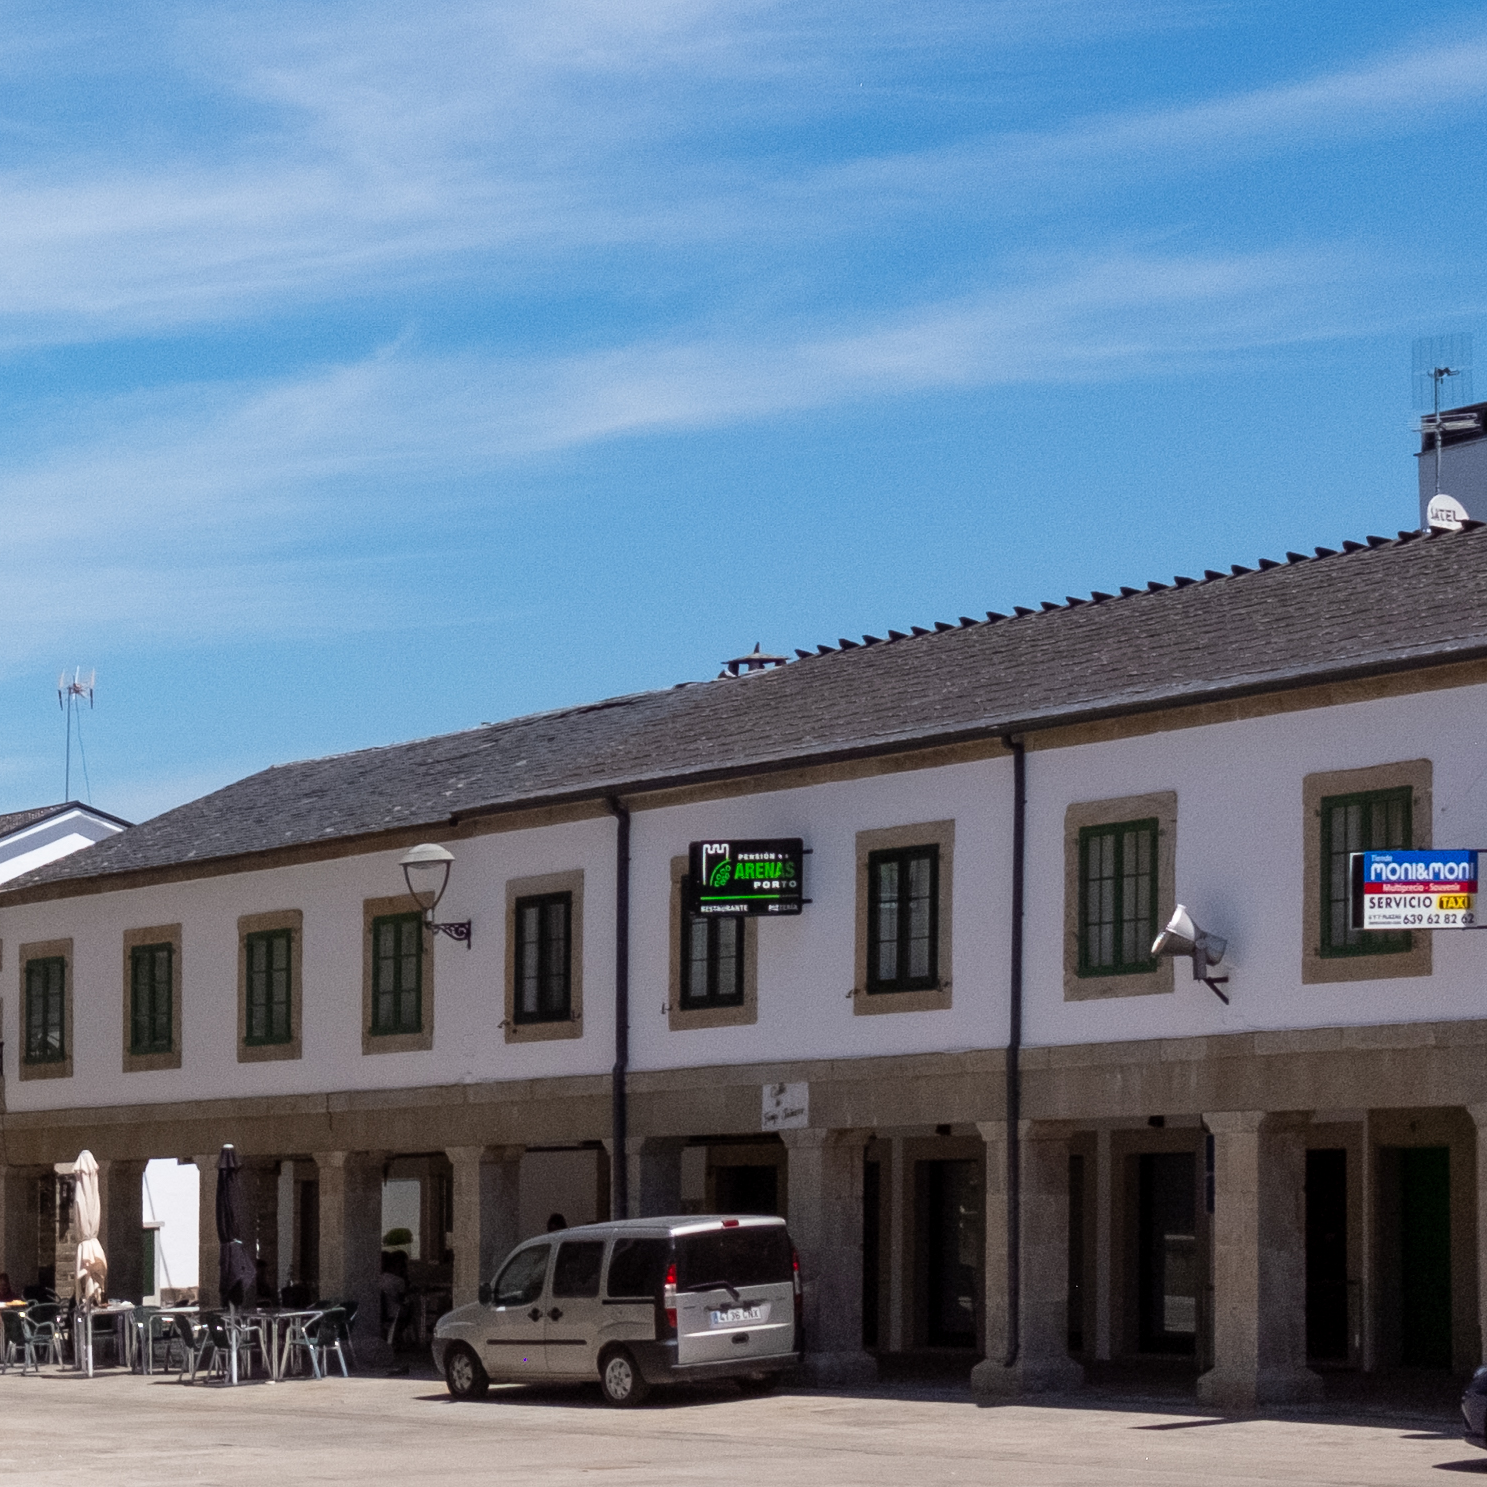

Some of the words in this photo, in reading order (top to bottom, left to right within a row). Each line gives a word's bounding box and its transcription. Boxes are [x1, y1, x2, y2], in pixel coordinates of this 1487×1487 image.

[738, 852, 776, 861] PENSIÓN
[734, 861, 796, 880] ARENAS
[753, 880, 797, 889] PORTO
[1382, 883, 1424, 893] Multiprecio
[1429, 883, 1461, 892] Souvenir
[1369, 896, 1433, 909] SERVICIO
[1441, 897, 1469, 909] TAXI
[700, 904, 749, 912] RESTAURANTE
[1403, 914, 1423, 925] 639
[1427, 913, 1441, 925] 62
[1444, 913, 1458, 924] 82
[1461, 913, 1475, 924] 62
